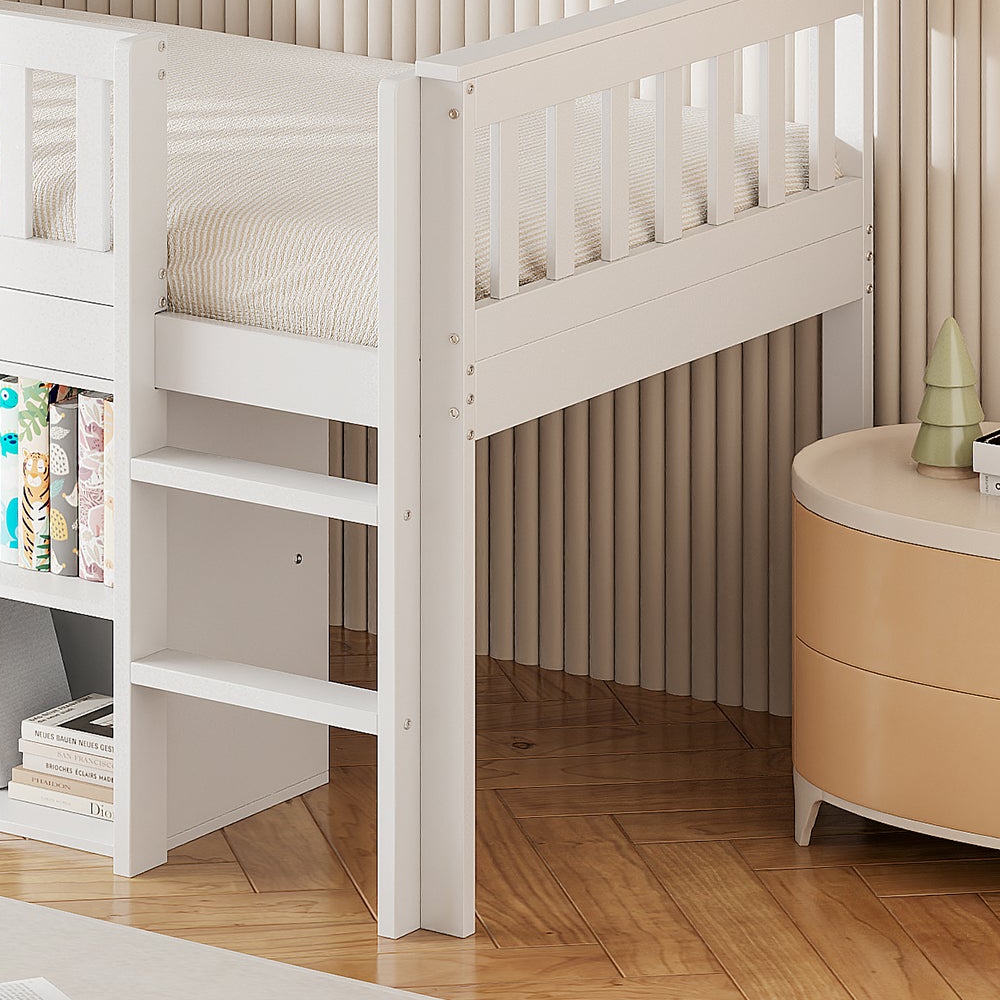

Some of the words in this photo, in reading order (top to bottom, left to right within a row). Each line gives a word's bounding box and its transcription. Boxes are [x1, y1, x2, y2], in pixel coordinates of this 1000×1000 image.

[34, 730, 54, 740] NEUES
[56, 734, 77, 745] BAUEN
[78, 739, 99, 750] NEUES
[100, 743, 114, 753] GEST
[45, 762, 73, 774] BRIOCHES
[74, 753, 114, 769] FRANCISC
[89, 802, 113, 819] Dio
